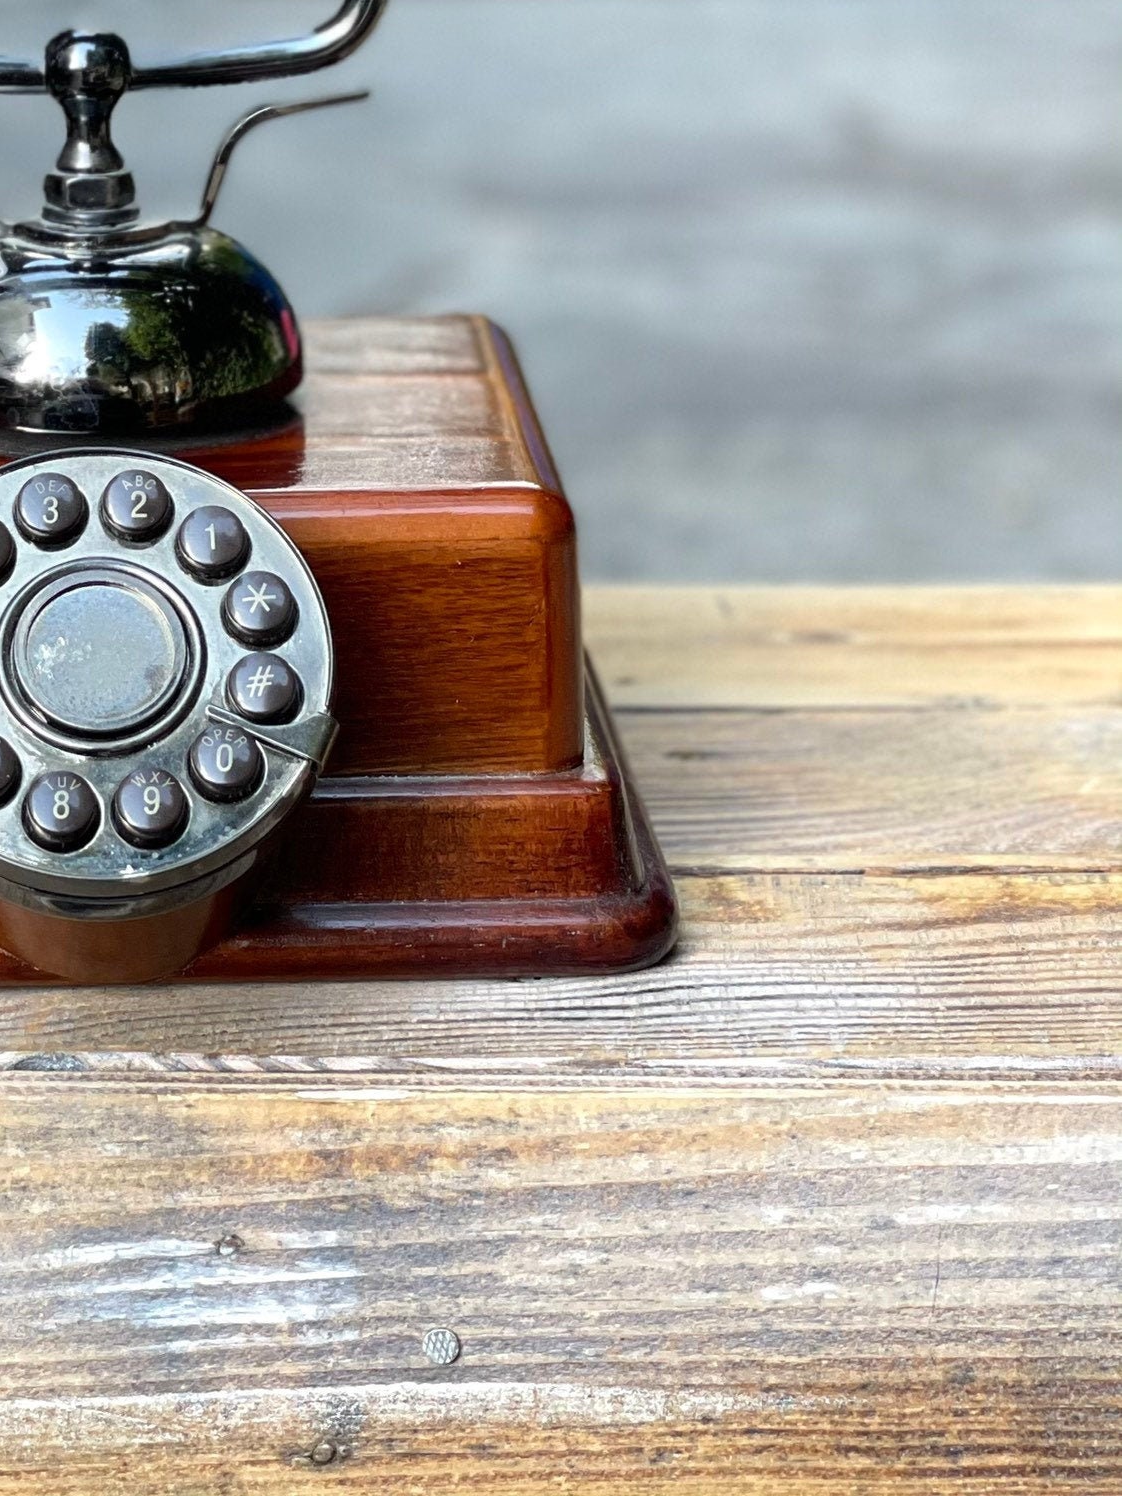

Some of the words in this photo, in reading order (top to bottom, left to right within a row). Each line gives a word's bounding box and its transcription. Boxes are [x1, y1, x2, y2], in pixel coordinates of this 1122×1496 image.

[34, 479, 70, 494] DEF
[122, 475, 157, 491] ABC
[42, 496, 59, 524] 3
[130, 490, 148, 519] 2
[204, 523, 216, 551] 1
[246, 665, 274, 698] #
[201, 729, 248, 748] OPER
[43, 776, 82, 791] TUV
[131, 771, 175, 788] WXY
[52, 790, 70, 819] 8
[143, 785, 160, 815] 9
